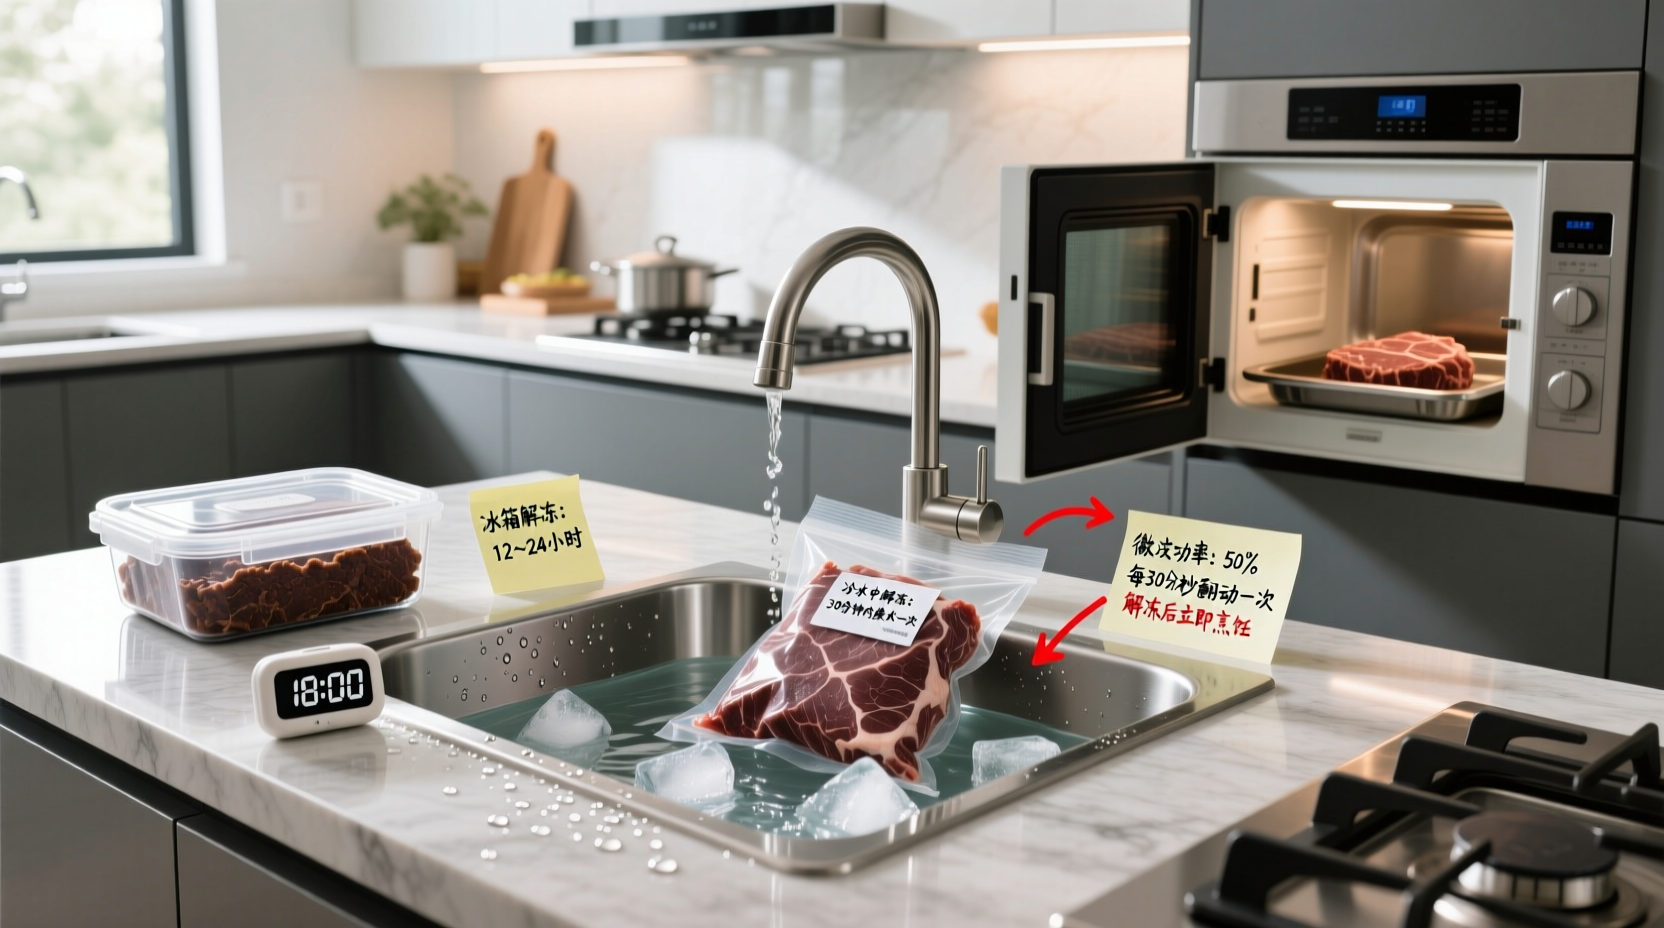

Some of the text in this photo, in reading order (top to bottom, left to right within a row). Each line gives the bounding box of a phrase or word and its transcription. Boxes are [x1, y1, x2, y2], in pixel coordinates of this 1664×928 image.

[1122, 591, 1252, 637] 解冻后立即烹饪
[293, 668, 364, 707] 18:00
